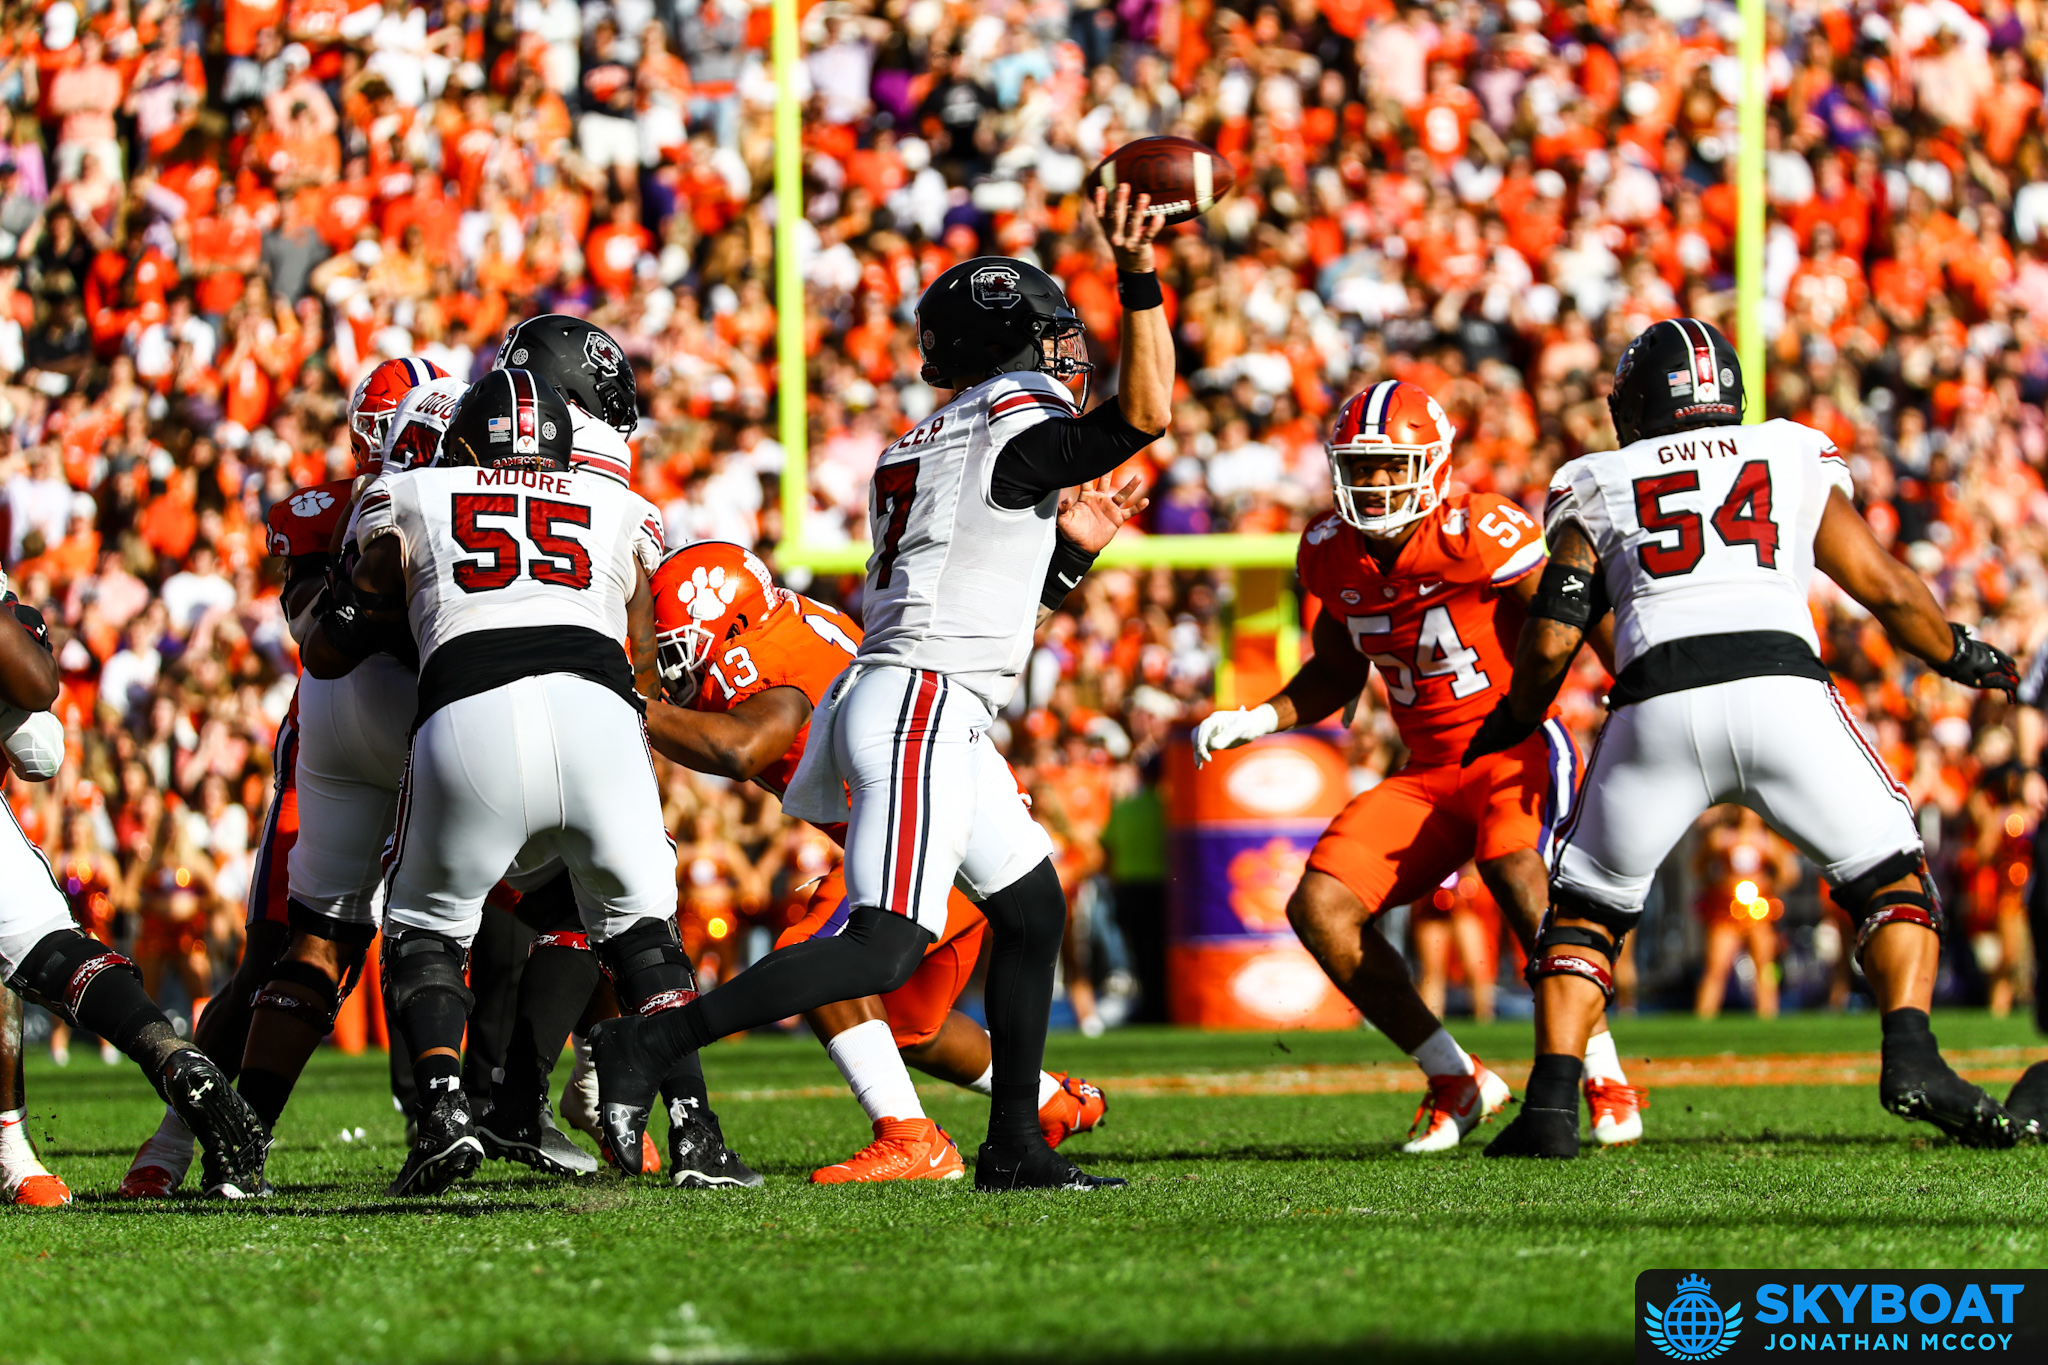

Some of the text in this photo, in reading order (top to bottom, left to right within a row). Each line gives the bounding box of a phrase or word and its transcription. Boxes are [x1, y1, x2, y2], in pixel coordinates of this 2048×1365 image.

[1658, 438, 1738, 464] GWYN
[477, 470, 572, 496] MOORE
[452, 493, 593, 593] 55
[874, 457, 920, 591] 7
[1477, 505, 1534, 548] 54
[1633, 460, 1780, 579] 54
[709, 646, 759, 700] 13
[1346, 605, 1491, 706] 54
[640, 993, 682, 1013] DONJOY
